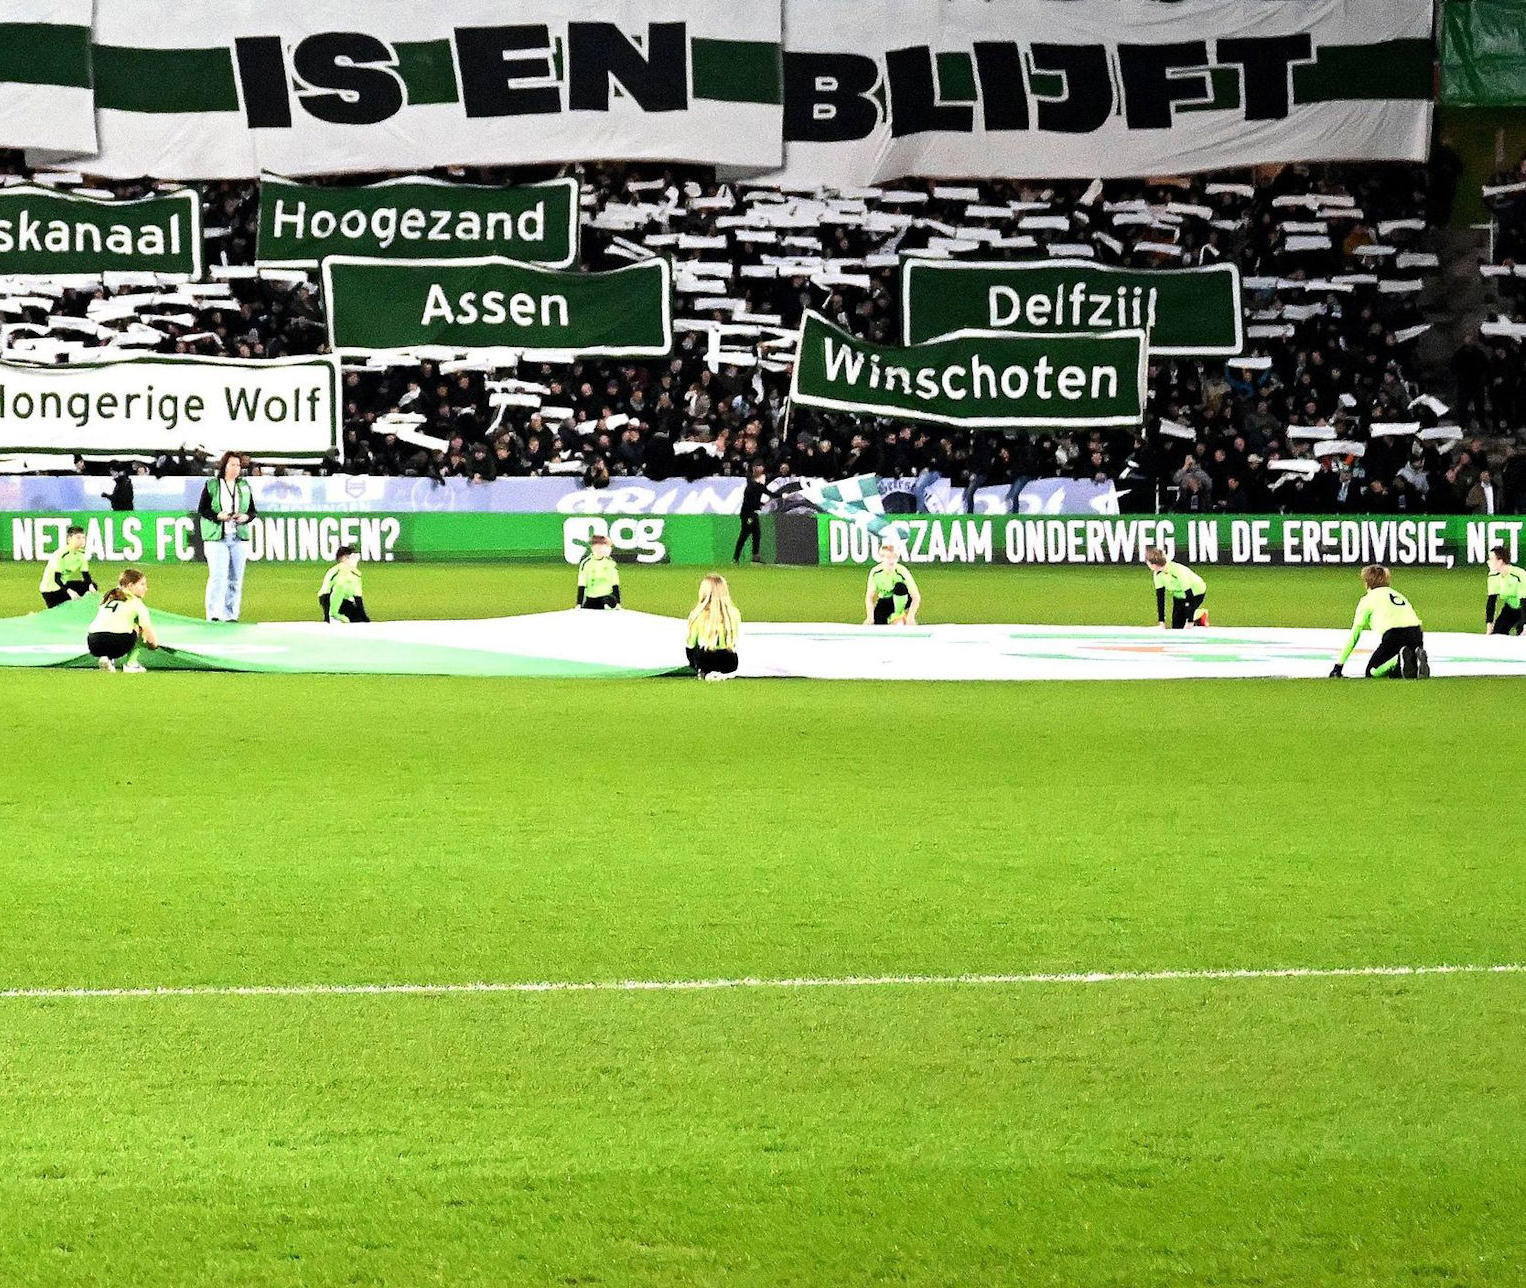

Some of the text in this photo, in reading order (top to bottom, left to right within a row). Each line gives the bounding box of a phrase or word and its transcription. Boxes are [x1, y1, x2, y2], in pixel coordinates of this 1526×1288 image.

[233, 32, 402, 129] IS
[454, 22, 689, 120] EN
[783, 33, 1313, 143] BLIJFT
[272, 199, 545, 249] Hoogezand
[420, 283, 570, 327] Assen
[822, 336, 1118, 401] Winschoten
[224, 386, 322, 423] Wolf
[12, 517, 72, 562] NET
[85, 517, 144, 563] ALS
[156, 516, 195, 563] FC
[248, 516, 401, 563] ONINGEN?
[1005, 519, 1176, 563] ONDERWEG
[1187, 520, 1219, 563] IN
[1231, 520, 1271, 563] DE
[1283, 520, 1455, 570] EREDIVISIE,
[1466, 520, 1524, 564] NET
